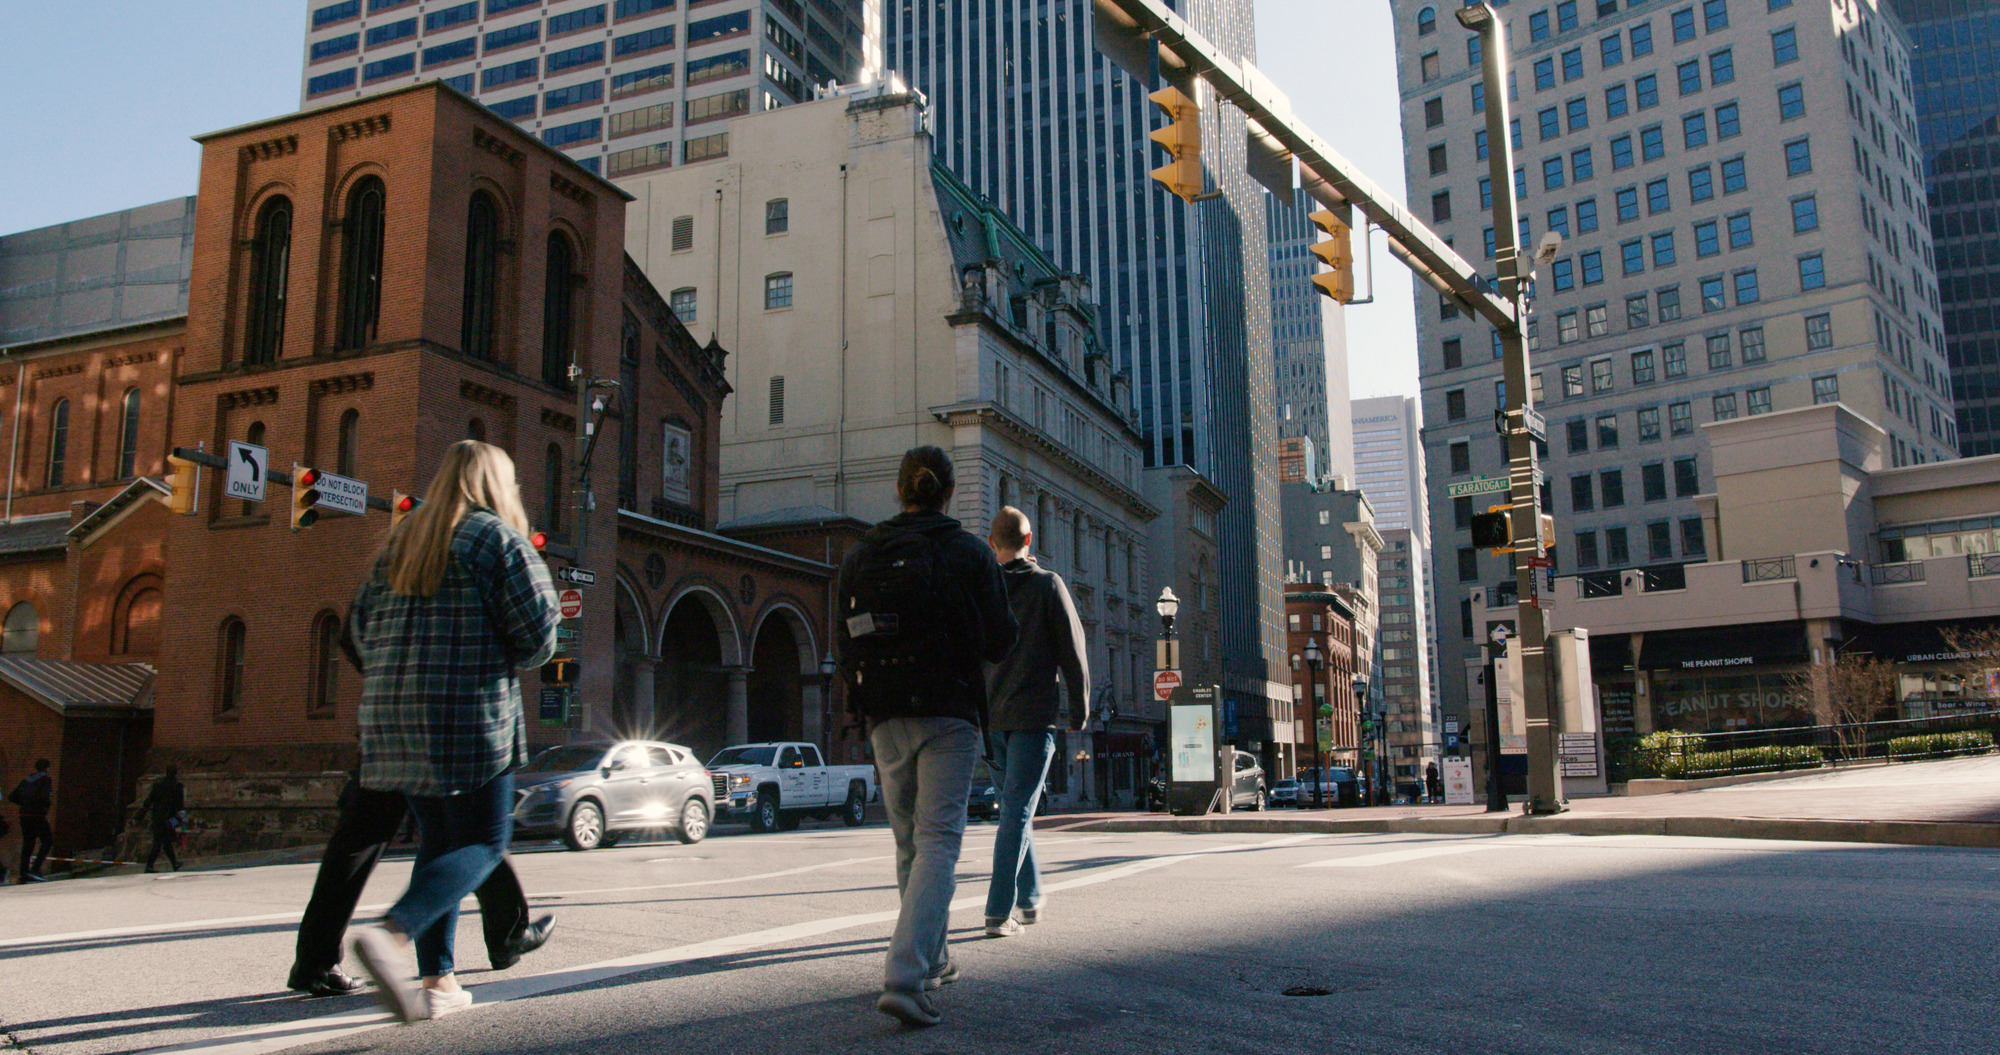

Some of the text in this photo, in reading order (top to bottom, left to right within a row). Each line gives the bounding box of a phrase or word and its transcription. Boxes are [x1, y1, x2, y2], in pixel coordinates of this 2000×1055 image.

[1352, 415, 1397, 425] ANSAMERICA
[232, 481, 260, 496] ONLY
[316, 476, 366, 497] DO NOT BLOCK
[1449, 486, 1456, 496] W
[1457, 480, 1501, 495] SARATOGA
[319, 491, 364, 510] NTERSECTION
[1681, 656, 1754, 669] THE PEANUT SHOPPE
[1906, 653, 1935, 661] URBAN
[1964, 700, 1987, 708] Wine
[1447, 736, 1457, 746] P
